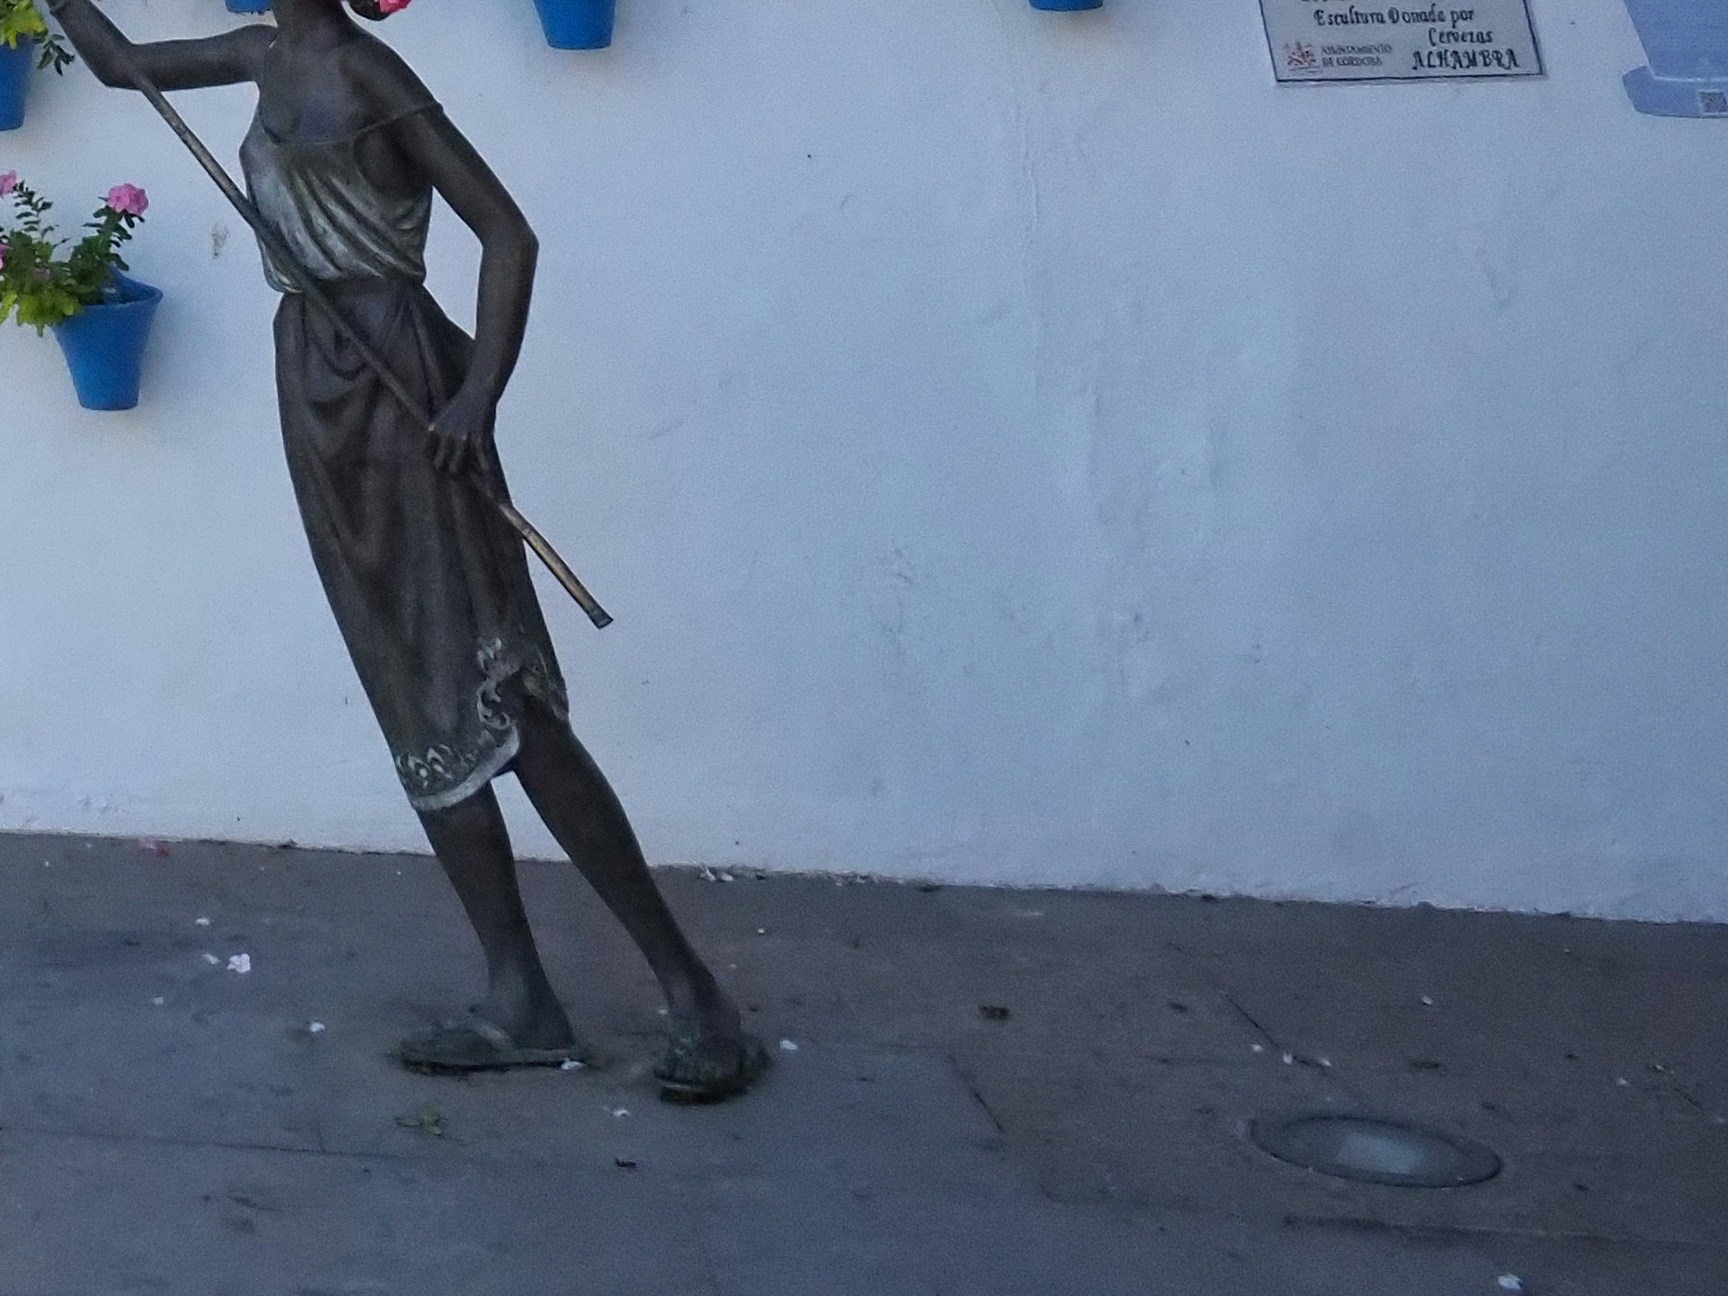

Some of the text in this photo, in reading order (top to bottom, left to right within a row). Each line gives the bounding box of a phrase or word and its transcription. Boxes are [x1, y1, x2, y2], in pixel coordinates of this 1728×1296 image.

[1313, 5, 1386, 26] Escultura
[1450, 9, 1475, 29] por
[1428, 27, 1494, 47] Cervezas
[1412, 48, 1520, 71] ALHAMBRA
